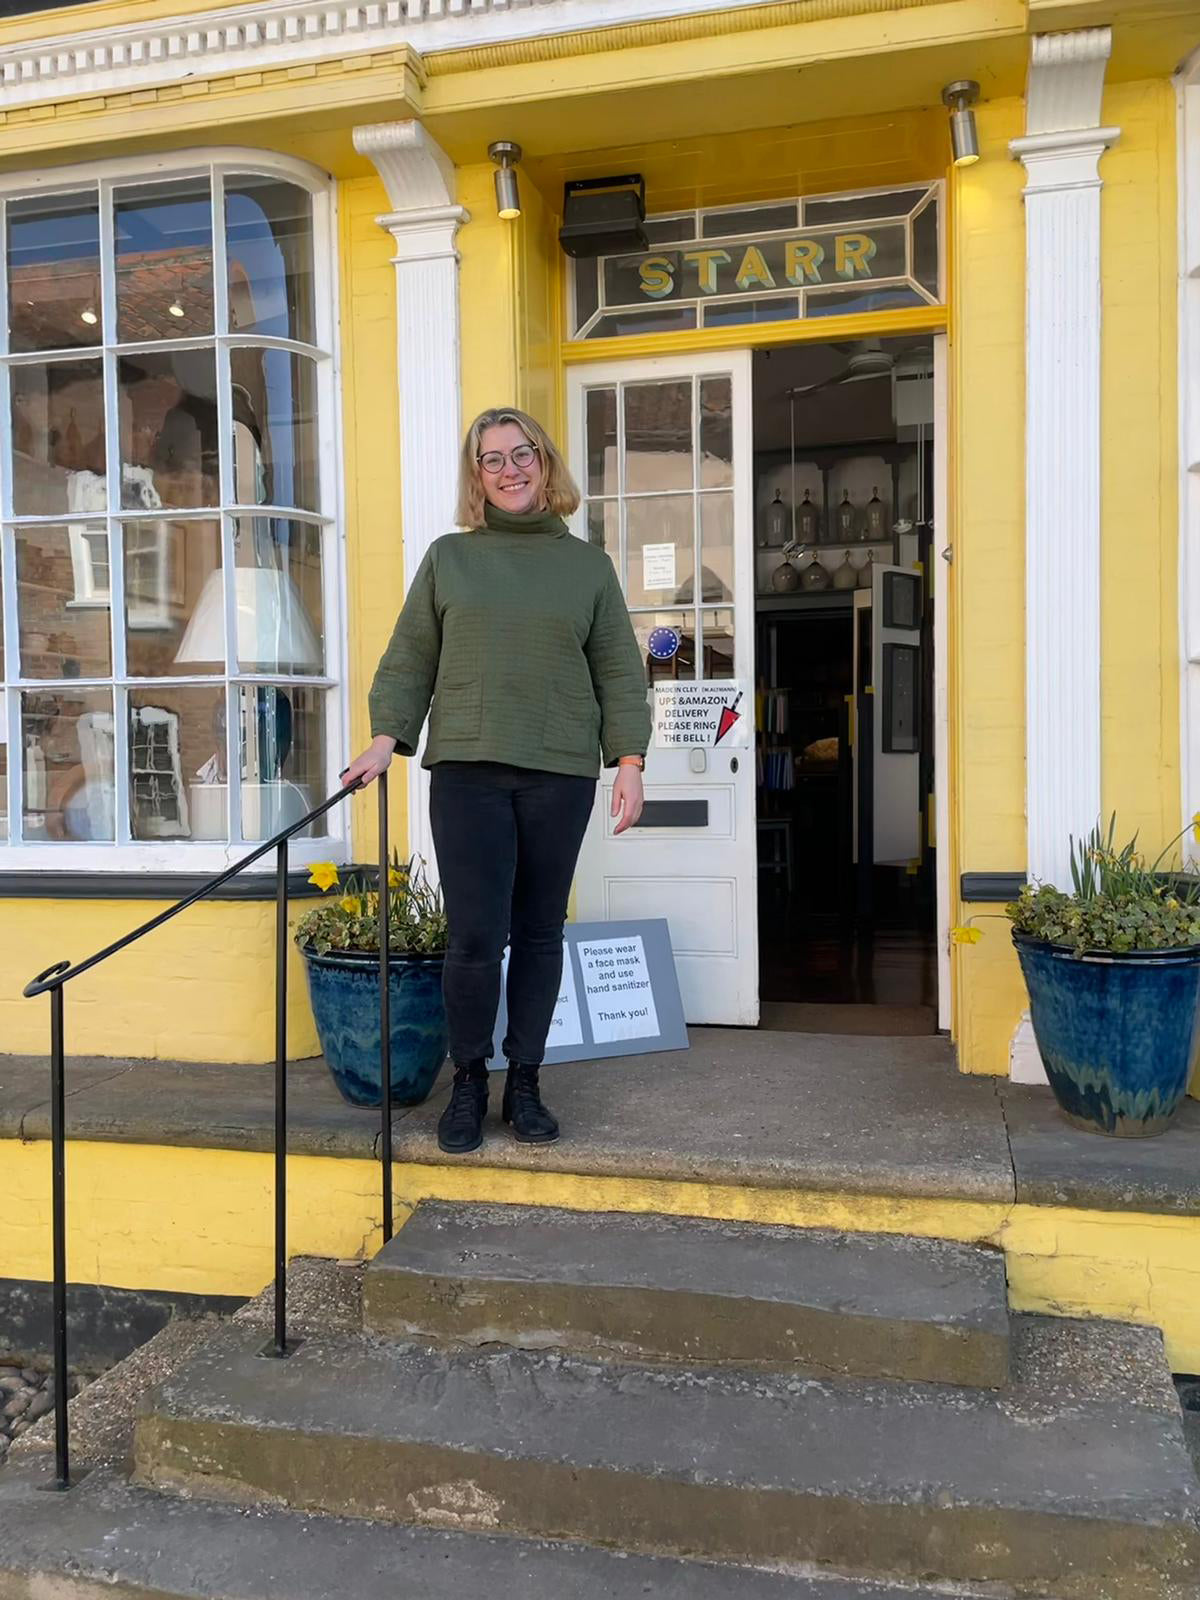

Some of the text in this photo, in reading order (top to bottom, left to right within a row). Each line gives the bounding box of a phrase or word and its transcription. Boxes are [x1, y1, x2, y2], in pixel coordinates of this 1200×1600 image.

[639, 234, 877, 298] STARR
[659, 696, 677, 706] UPS
[665, 709, 709, 718] DELIVERY
[658, 721, 716, 731] PLEASE RING
[664, 734, 681, 743] THE
[583, 944, 637, 957] Please wear
[587, 956, 641, 969] a face mask
[598, 969, 634, 980] and use
[587, 979, 650, 994] hand sanitizer
[597, 1007, 649, 1022] Thank you!
